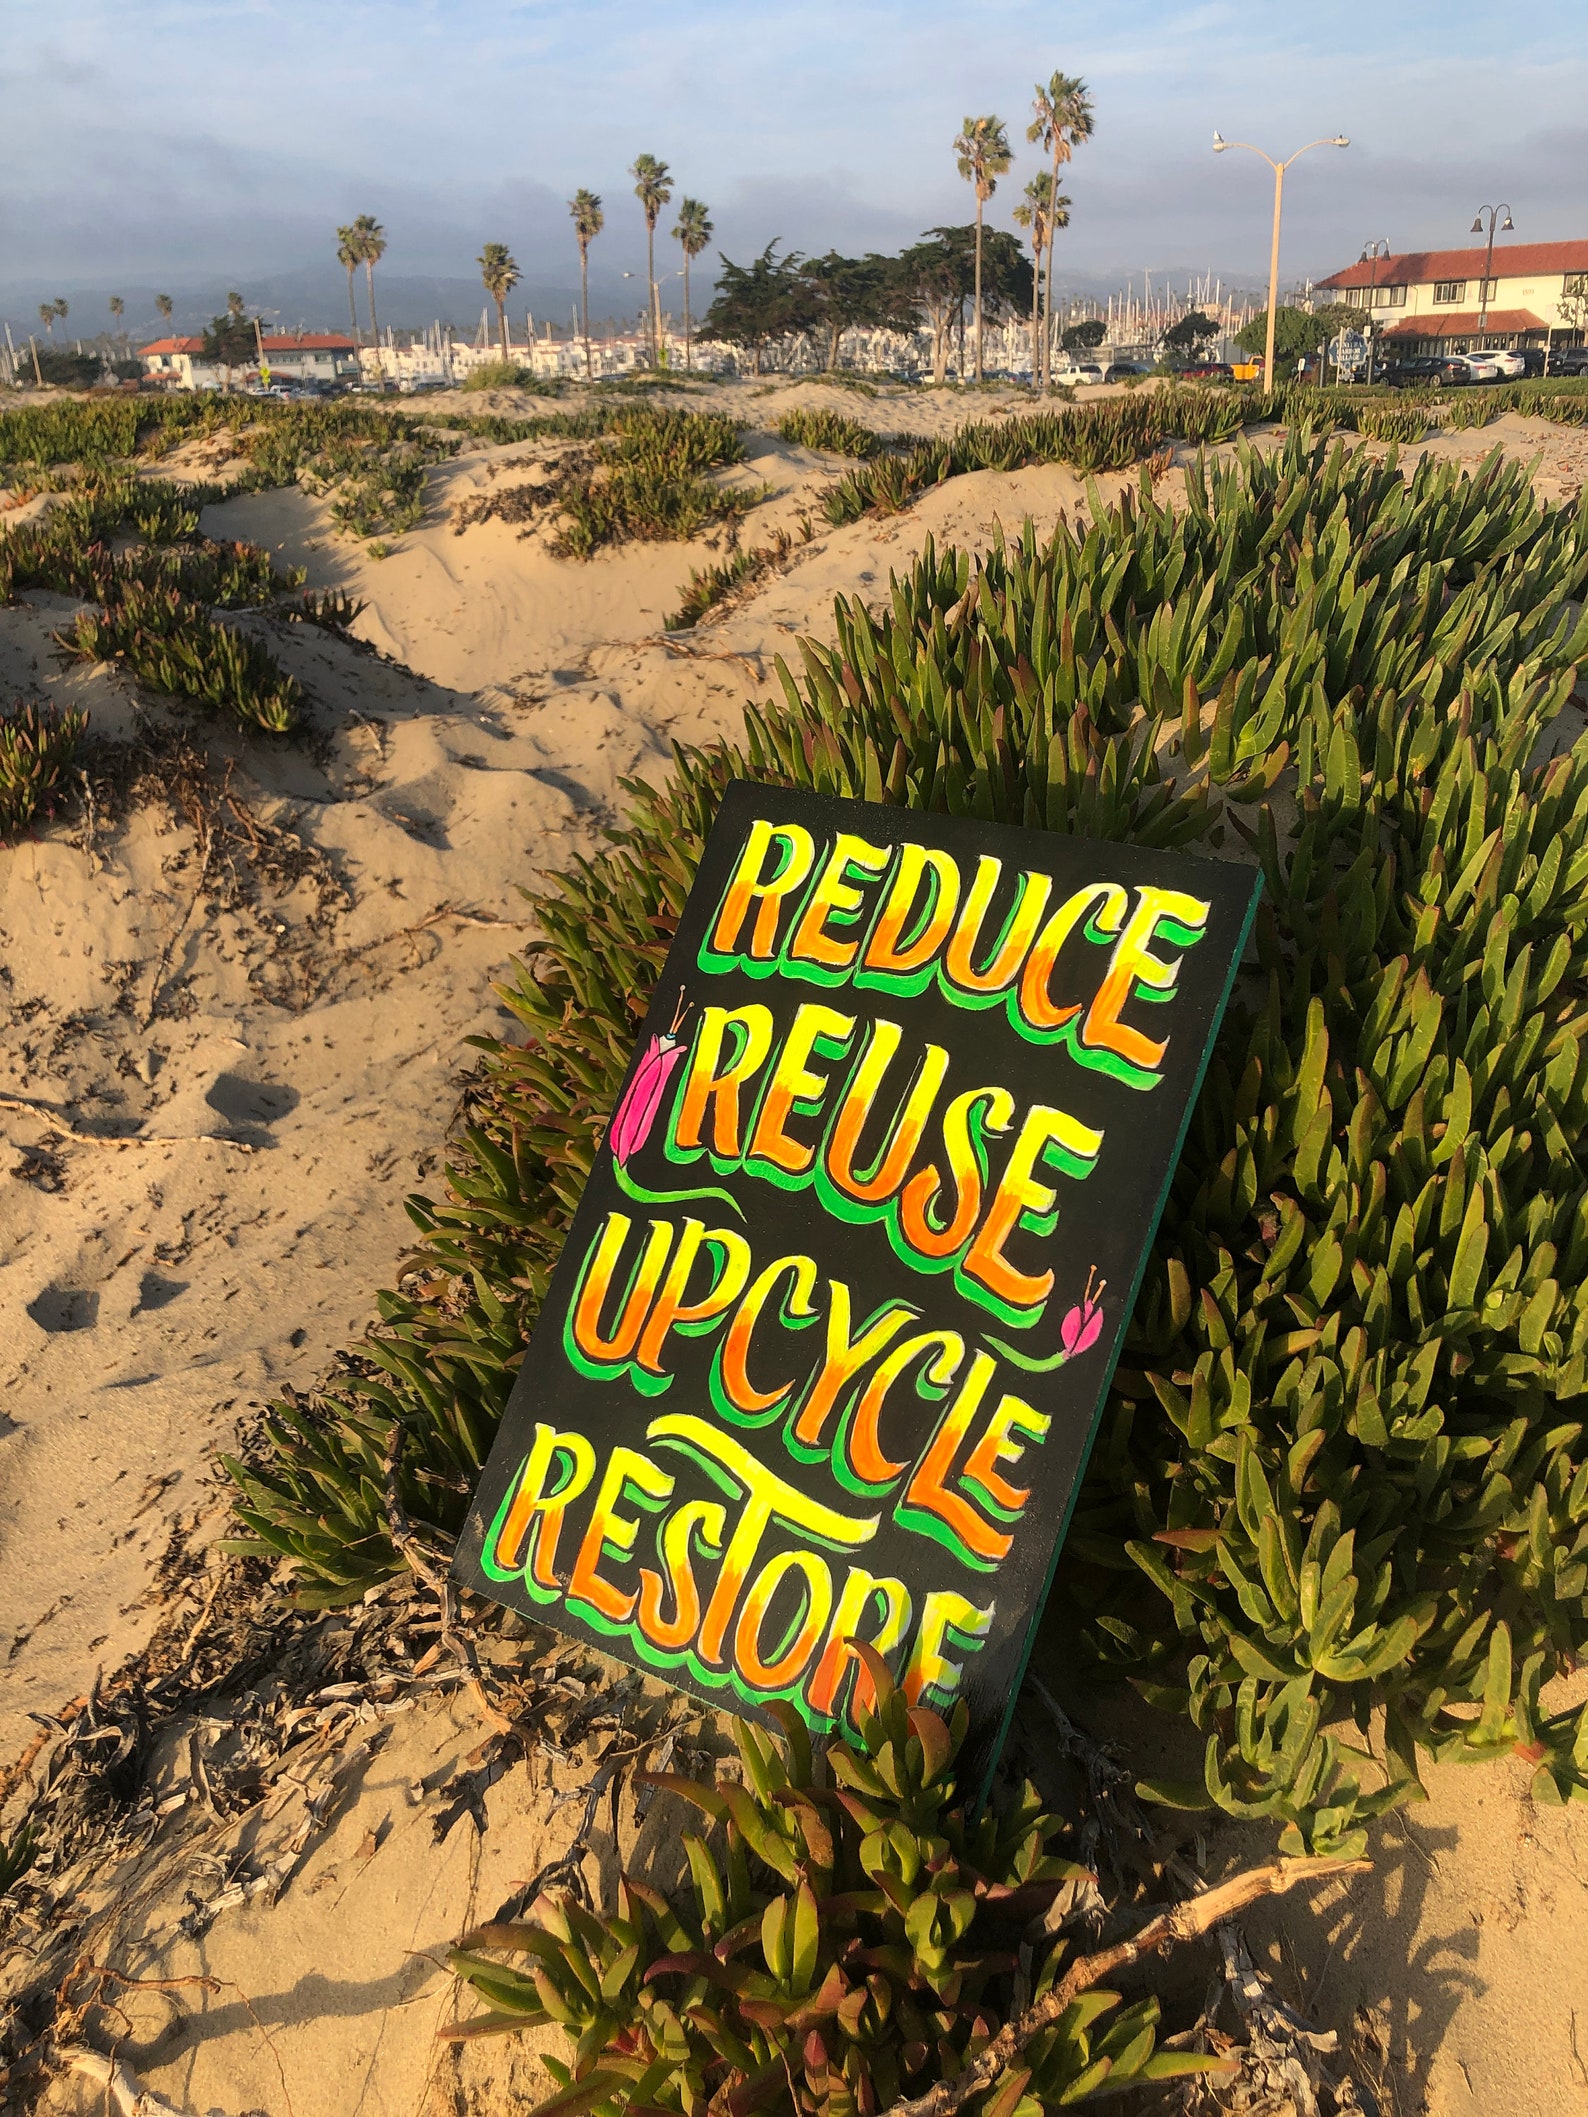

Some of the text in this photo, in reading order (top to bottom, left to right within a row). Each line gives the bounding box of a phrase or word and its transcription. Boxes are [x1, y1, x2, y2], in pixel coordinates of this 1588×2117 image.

[696, 819, 1211, 1090] REDUCE
[667, 1003, 1105, 1330] REUSE
[563, 1210, 1052, 1573] UPCYCLE
